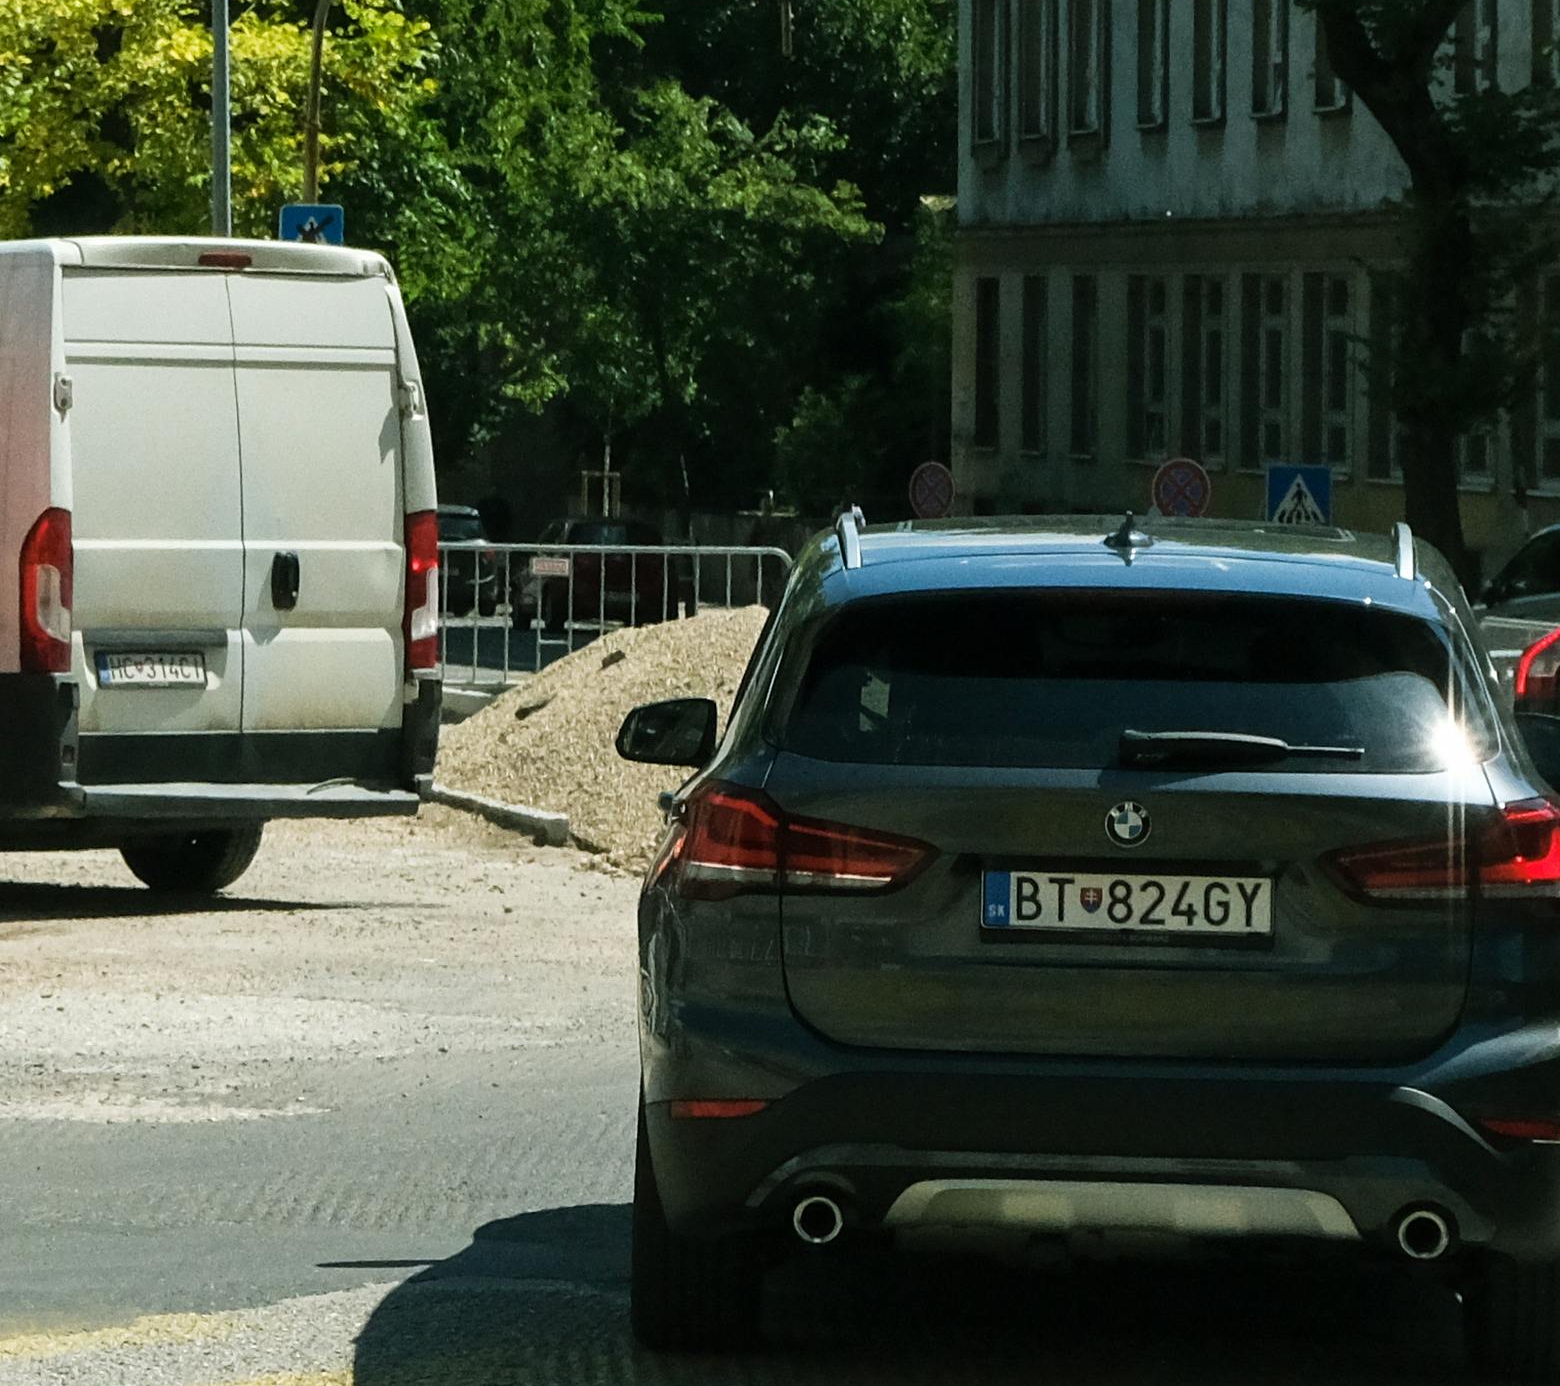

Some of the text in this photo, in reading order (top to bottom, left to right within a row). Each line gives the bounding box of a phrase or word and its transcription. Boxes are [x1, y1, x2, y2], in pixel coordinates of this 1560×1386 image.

[989, 904, 1006, 917] SK
[1016, 876, 1262, 927] BT 824GY
